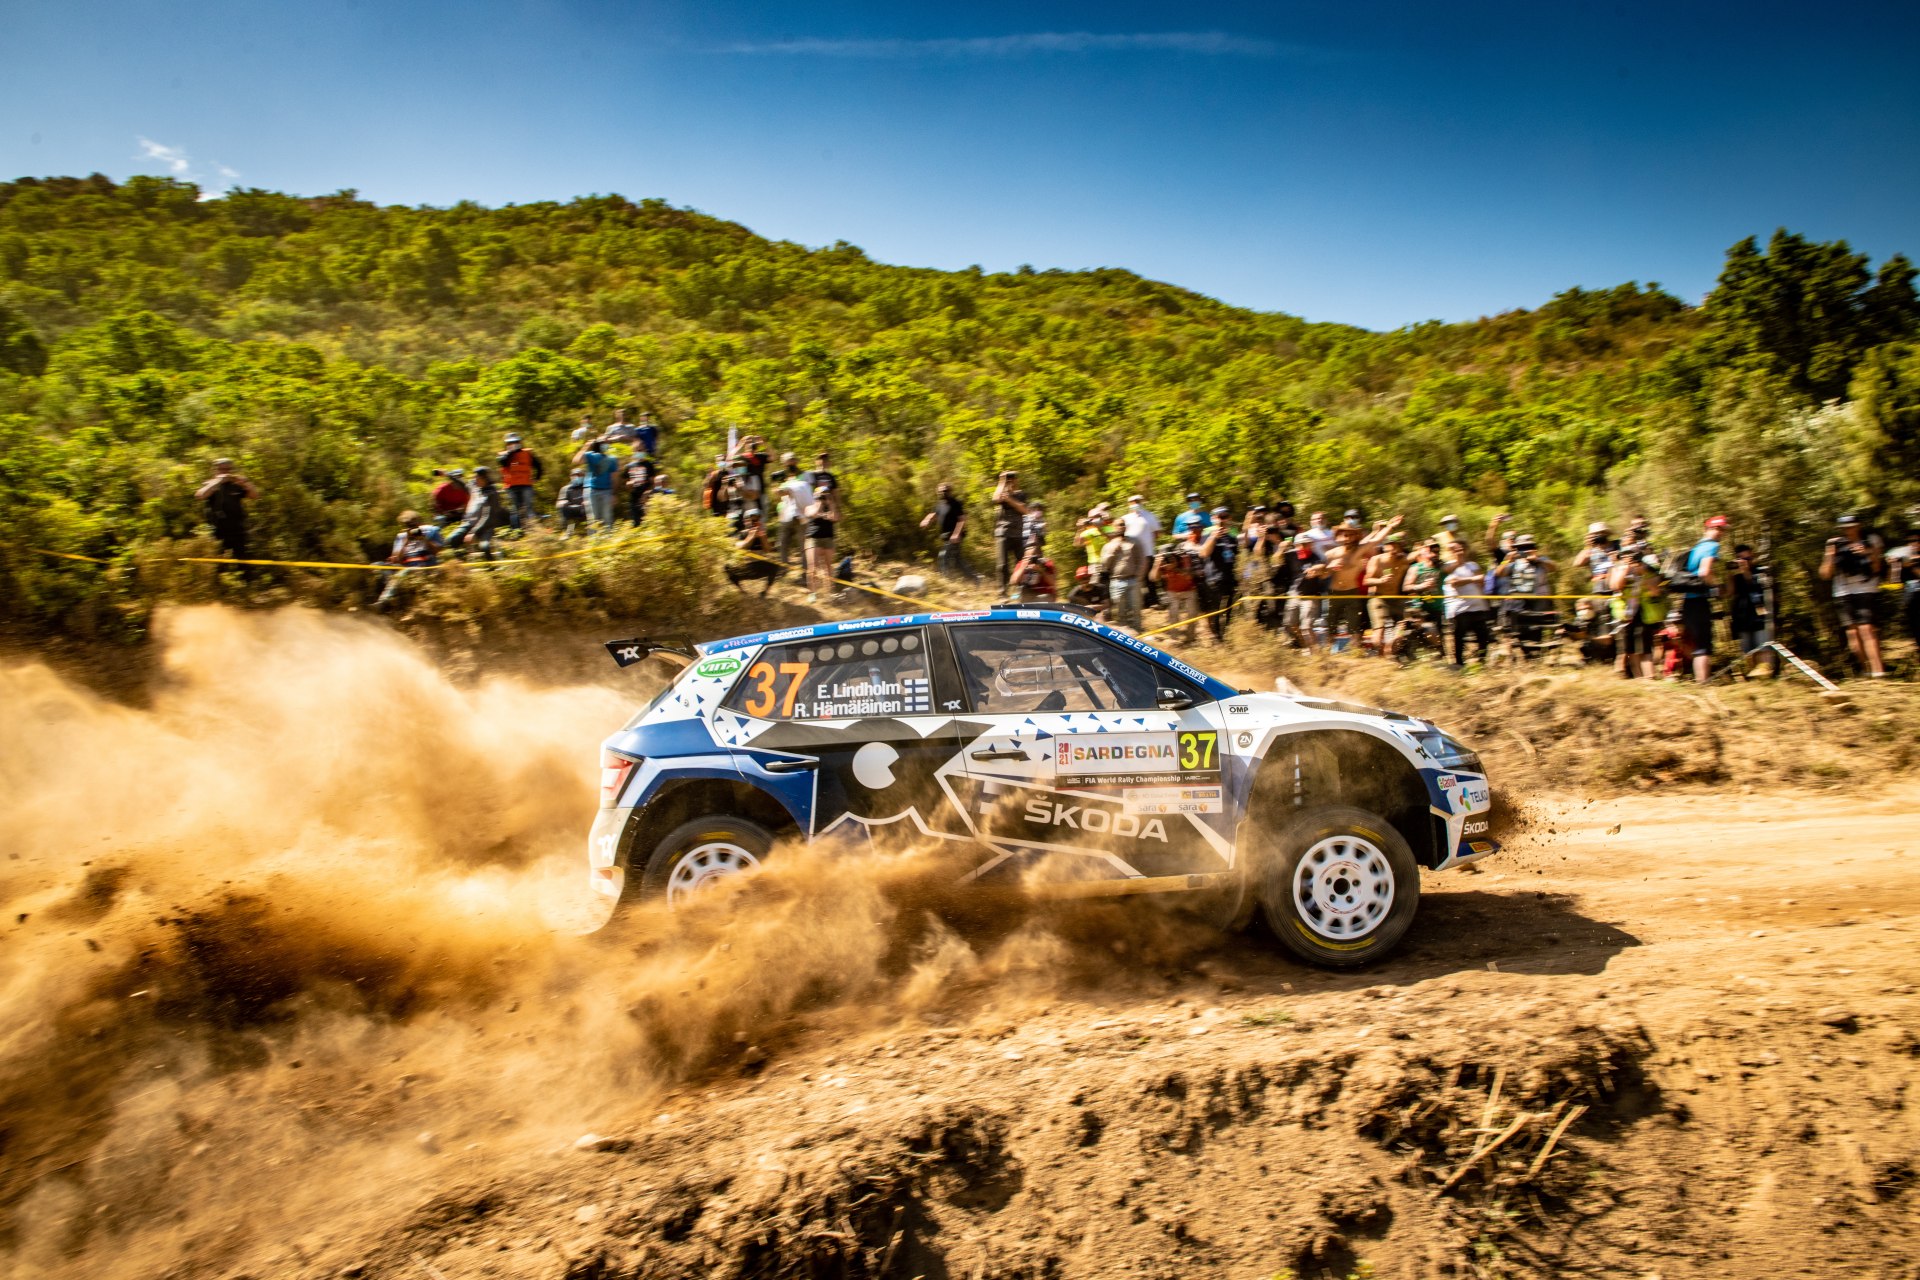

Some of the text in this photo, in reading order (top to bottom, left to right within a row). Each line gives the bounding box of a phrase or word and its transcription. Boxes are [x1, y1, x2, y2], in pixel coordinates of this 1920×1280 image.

[1060, 614, 1103, 633] GRX
[1108, 630, 1159, 659] PESEBA
[700, 661, 738, 673] VIITA
[745, 662, 809, 717] 37
[818, 681, 900, 699] E. Lindholm
[795, 701, 900, 718] R. Hämäläinen
[1074, 745, 1175, 760] SARDEGNA
[1179, 732, 1217, 770] 37
[1097, 776, 1116, 784] World
[1118, 776, 1134, 784] Rally
[1135, 775, 1181, 784] Championship
[1178, 803, 1197, 811] sara
[1024, 795, 1169, 842] ŠKODA
